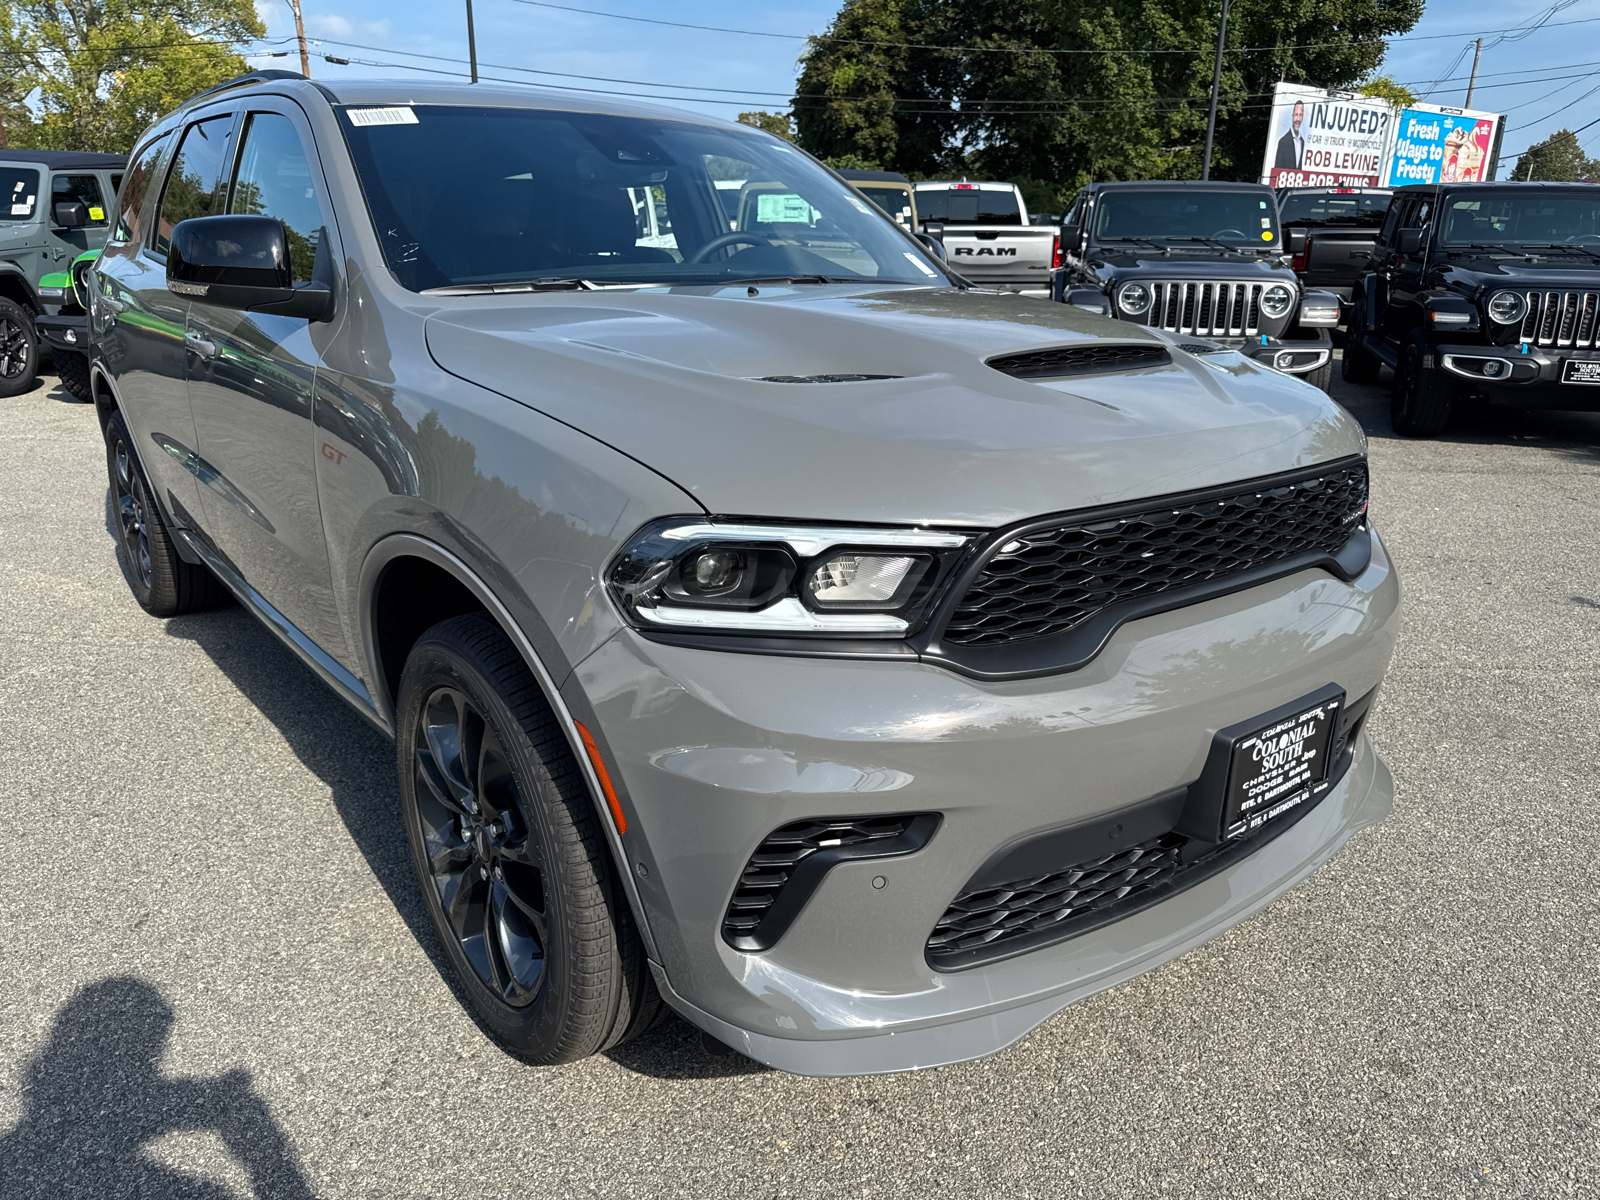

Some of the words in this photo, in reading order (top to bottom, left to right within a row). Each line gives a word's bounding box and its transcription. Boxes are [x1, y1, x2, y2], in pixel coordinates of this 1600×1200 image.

[1309, 102, 1388, 136] INJURED?
[1407, 118, 1440, 140] Fresh
[1329, 136, 1345, 146] TRUCK
[1396, 138, 1429, 164] Ways
[1430, 143, 1443, 160] to
[1304, 149, 1332, 168] ROB
[1334, 152, 1380, 172] LEVINE
[1396, 159, 1436, 184] Frosty
[954, 247, 1017, 256] RAM
[321, 441, 348, 467] GT
[1252, 721, 1316, 761] COLONIAL
[1242, 760, 1297, 789] CHRYSLER
[1301, 749, 1316, 761] Jeep
[1261, 740, 1304, 773] SOUTH
[1241, 798, 1257, 811] RTE.
[1257, 795, 1262, 804] 6
[1302, 770, 1311, 780] MA
[1248, 775, 1284, 797] DODGE
[1289, 762, 1308, 777] RAM
[1263, 813, 1268, 821] 6
[1301, 791, 1309, 801] MA
